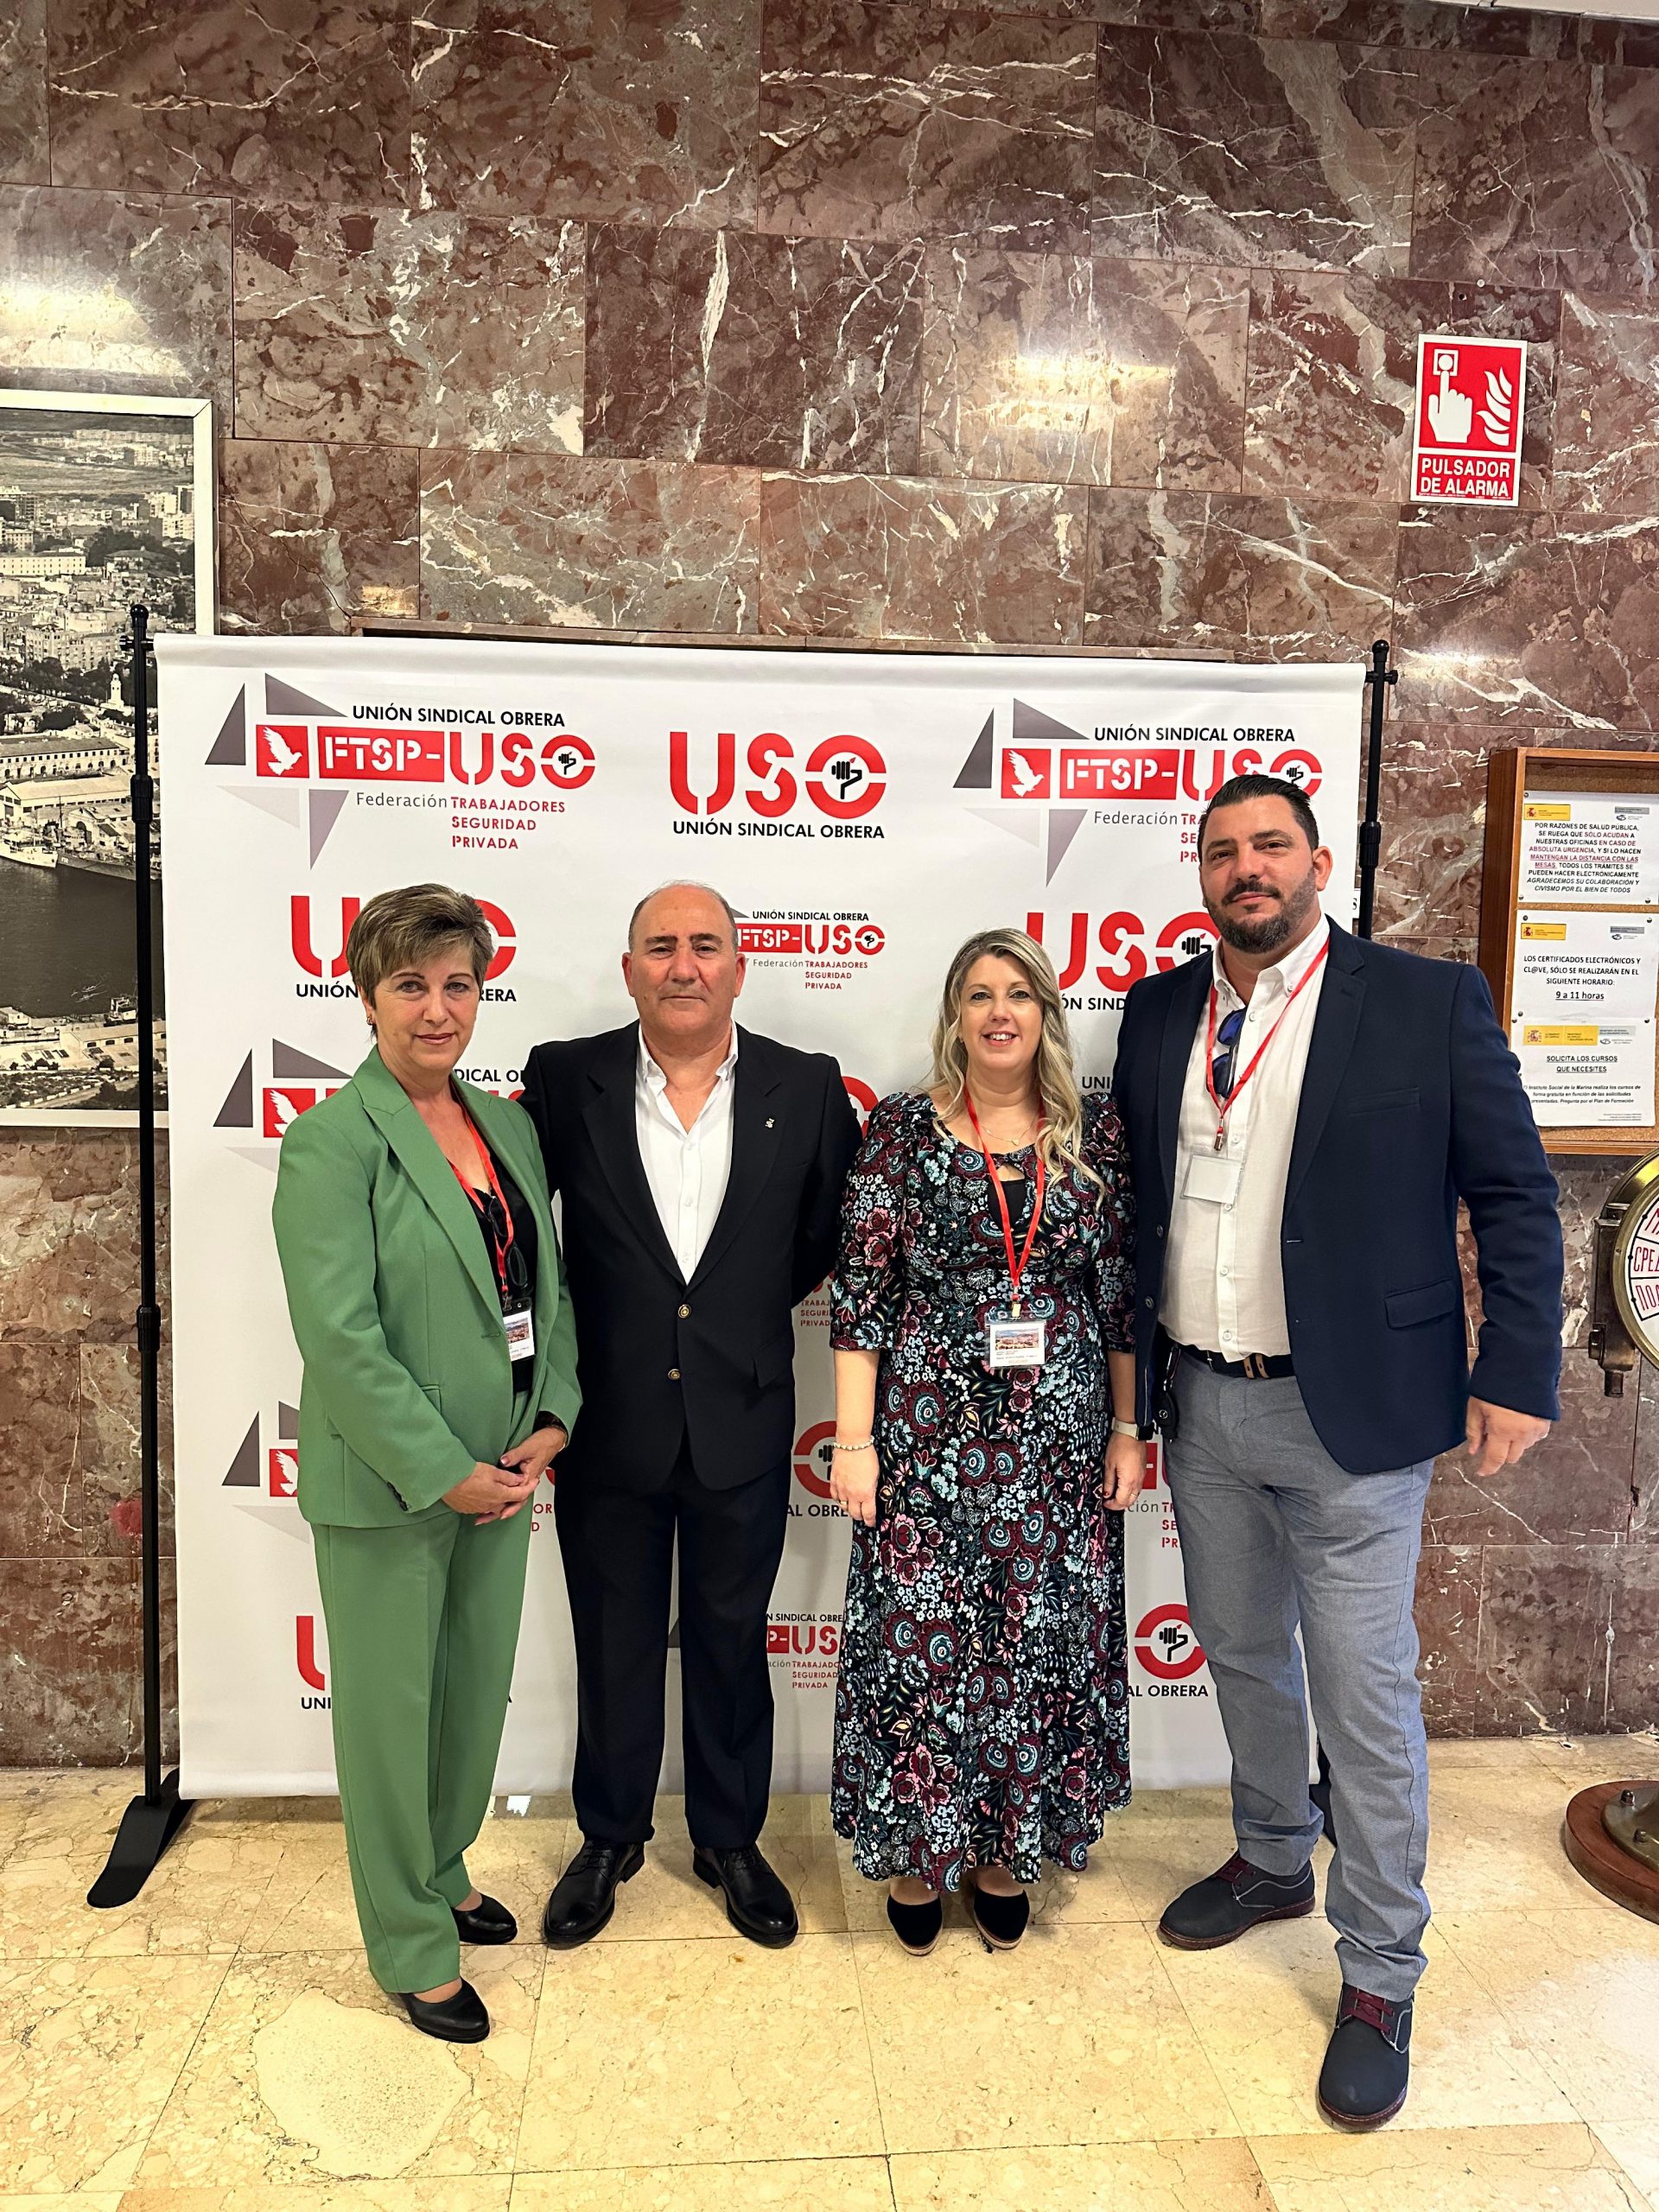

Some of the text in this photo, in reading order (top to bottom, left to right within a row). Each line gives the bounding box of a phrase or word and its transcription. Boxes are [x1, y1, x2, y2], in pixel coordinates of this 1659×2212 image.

[1421, 457, 1510, 478] PULSADOR
[1421, 477, 1509, 497] DE ALARMA
[353, 702, 565, 727] UNIÓN SINDICAL OBRERA
[1095, 724, 1295, 742] UNIÓN SINDICAL OBRERA
[670, 731, 887, 819] USO
[356, 792, 565, 813] Federación TRABAJADORES
[452, 817, 537, 830] SEGURIDAD
[1095, 810, 1178, 825] Federación
[673, 818, 885, 838] UNIÓN SINDICAL OBRERA
[452, 836, 518, 849] PRIVADA
[753, 909, 869, 921] UNIÓN SINDICAL OBRERA
[753, 959, 868, 969] Federación TRABAJADORES
[1586, 956, 1635, 964] ELECTRÓNICOS
[296, 981, 359, 998] UNIÓN
[805, 982, 842, 990] PRIVADA
[1582, 991, 1605, 999] horas
[454, 1069, 501, 1082] DICAL
[1082, 1077, 1111, 1089] UNI
[808, 1504, 849, 1517] OBRE
[776, 1613, 817, 1621] SINDICAL
[820, 1614, 842, 1622] OBRE
[1147, 1685, 1208, 1697] OBRERA
[302, 1697, 331, 1709] UNI
